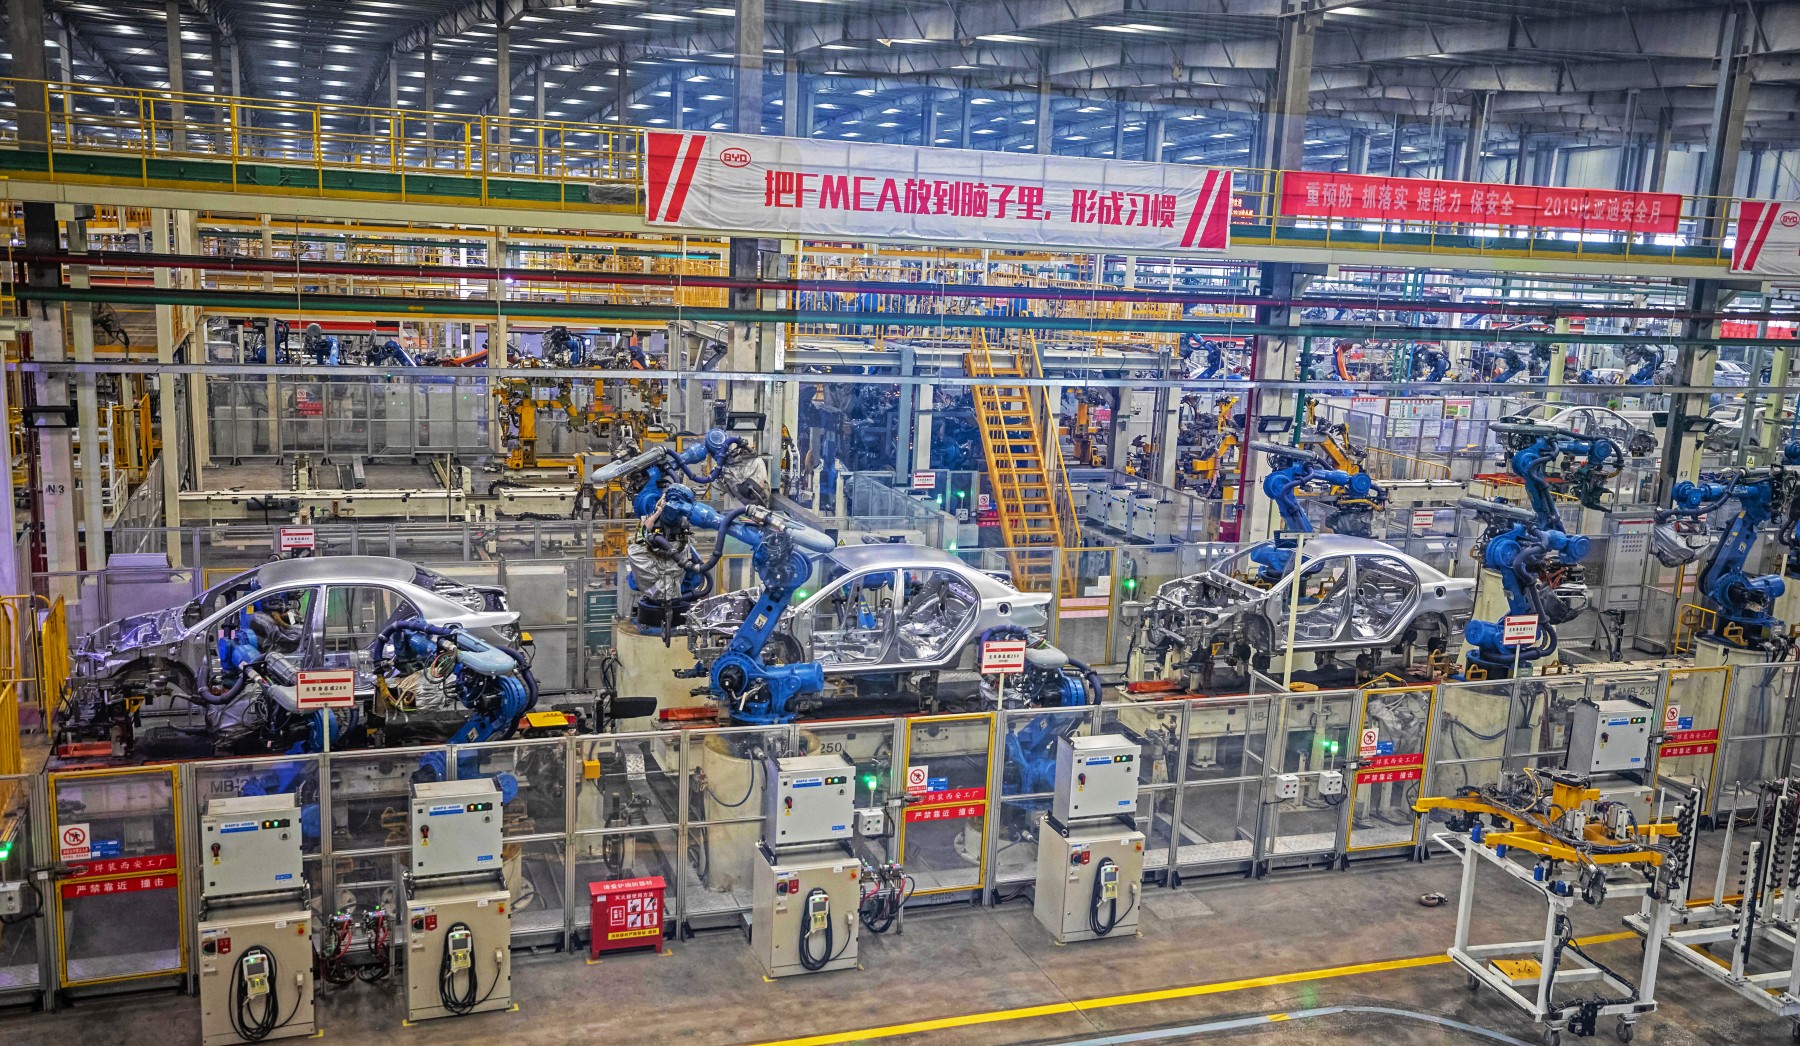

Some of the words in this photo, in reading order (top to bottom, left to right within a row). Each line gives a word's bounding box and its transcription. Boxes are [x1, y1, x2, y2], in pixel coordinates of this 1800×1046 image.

[1305, 181, 1353, 208] 重预防
[1362, 183, 1409, 211] 抓落实
[1416, 186, 1462, 213] 提能力
[94, 857, 167, 873] 焊装西安工厂
[76, 881, 128, 895] 严禁靠近
